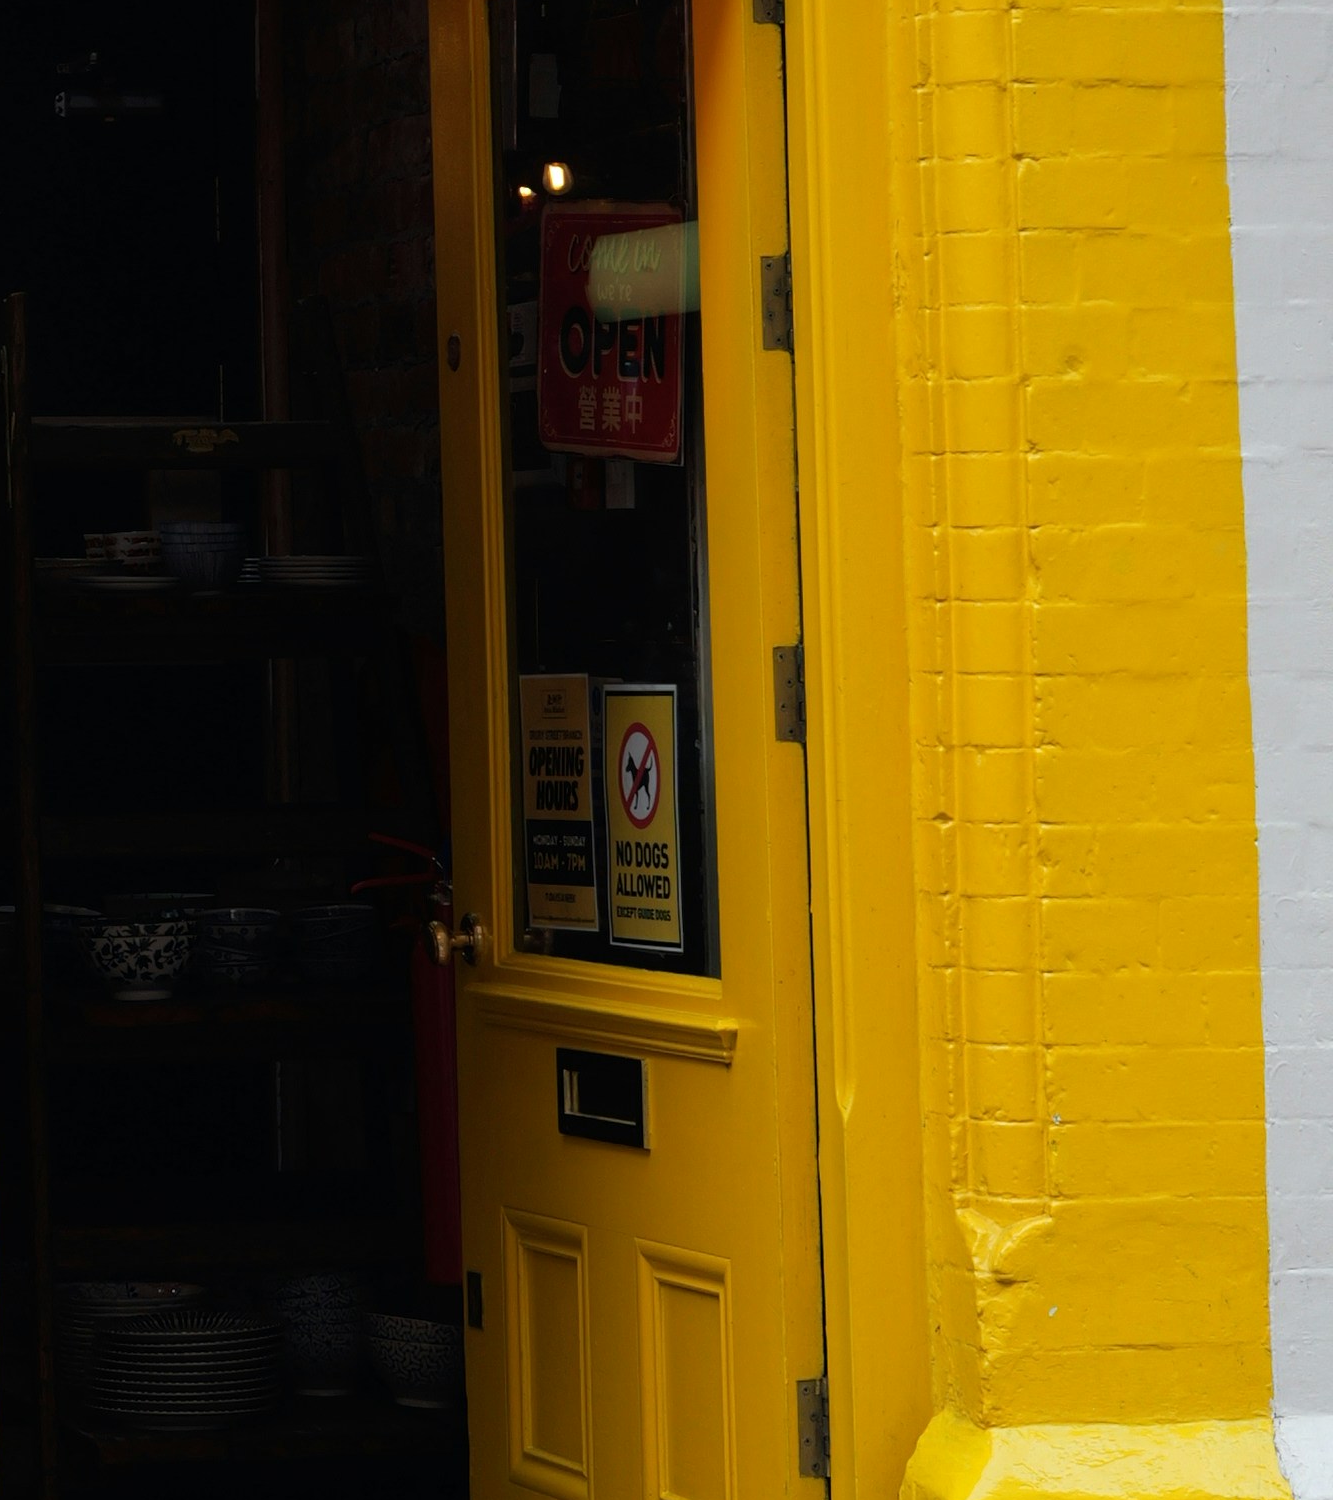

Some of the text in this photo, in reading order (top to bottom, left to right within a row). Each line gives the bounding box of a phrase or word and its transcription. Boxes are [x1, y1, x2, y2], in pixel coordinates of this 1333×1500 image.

[559, 307, 665, 385] OPEN
[529, 746, 584, 778] OPENING
[536, 780, 578, 812] HOURS
[533, 851, 559, 872] 10AM
[566, 851, 586, 873] 7PM
[615, 840, 669, 869] NO DOGS
[616, 873, 671, 899] ALLOWED
[616, 906, 671, 922] EXCEPT GUIDE DOGS
